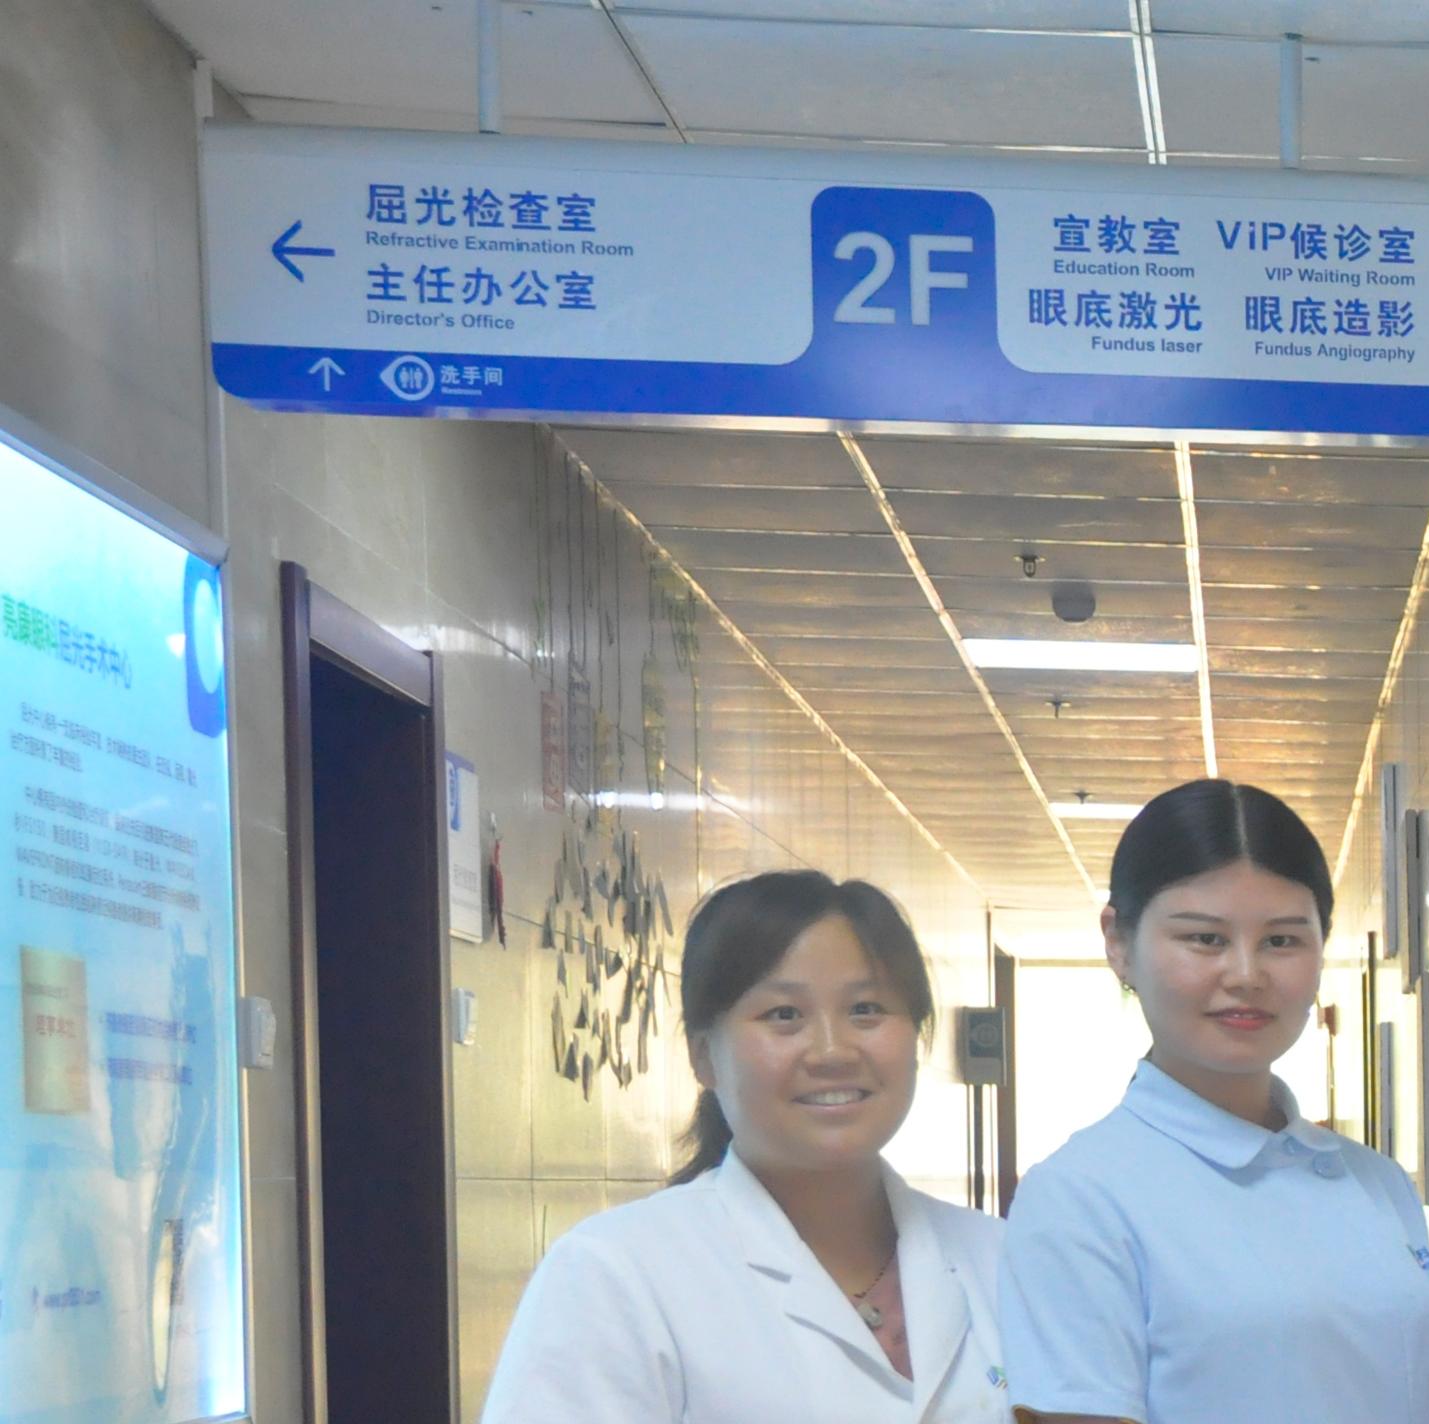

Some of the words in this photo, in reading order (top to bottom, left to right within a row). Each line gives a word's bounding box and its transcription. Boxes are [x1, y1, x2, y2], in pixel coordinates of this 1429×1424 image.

[366, 183, 596, 233] 屈光检查室
[365, 231, 459, 250] Refractive
[465, 235, 576, 255] Examination
[581, 241, 635, 257] Room
[1053, 213, 1181, 256] 宣教室
[1215, 220, 1416, 265] ViP候诊室
[833, 230, 974, 327] 2F
[1053, 259, 1140, 277] Education
[1145, 262, 1196, 279] Room
[1264, 267, 1293, 282] VIP
[1297, 267, 1361, 288] Waiting
[1366, 270, 1416, 287] Room
[366, 262, 597, 311] 主任办公室
[366, 309, 456, 329] Director's
[461, 313, 516, 331] Office
[1028, 288, 1203, 332] 眼底激光
[1245, 295, 1416, 338] 眼底造影
[1091, 336, 1156, 354] Fundus
[1160, 337, 1203, 355] laser
[1254, 341, 1313, 359] Fundus
[1317, 342, 1416, 364] Angiography
[440, 364, 504, 387] 洗手间
